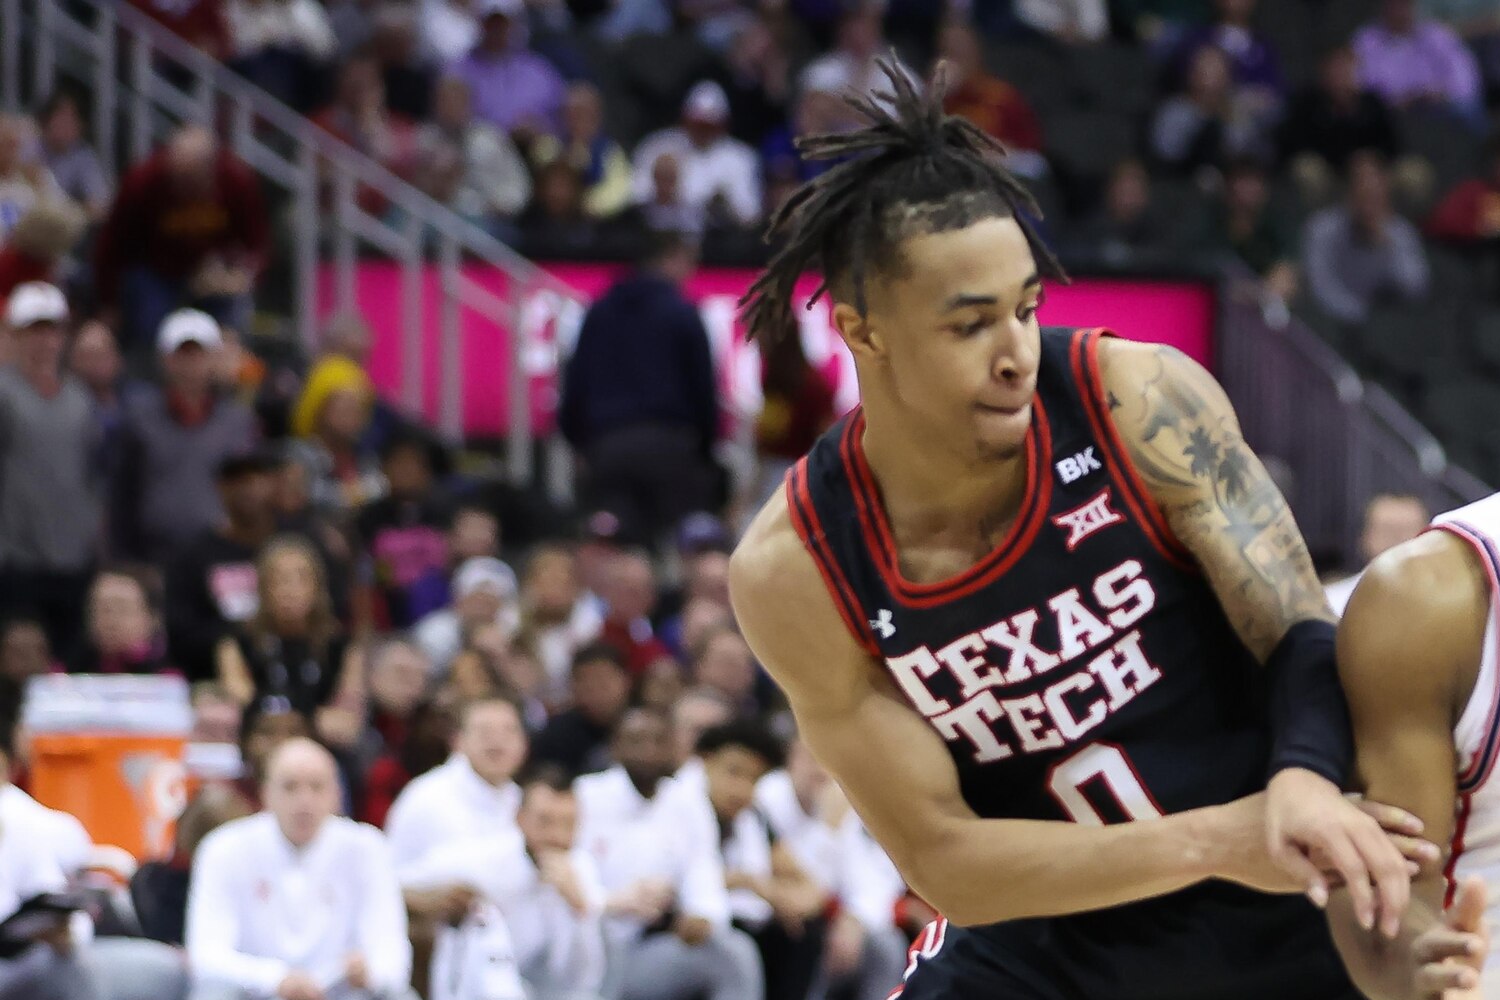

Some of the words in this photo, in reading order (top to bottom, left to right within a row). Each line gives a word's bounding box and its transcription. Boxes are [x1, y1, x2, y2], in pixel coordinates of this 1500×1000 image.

[1055, 445, 1102, 485] BK
[884, 557, 1157, 718] TEXAS
[929, 628, 1164, 765] TECH
